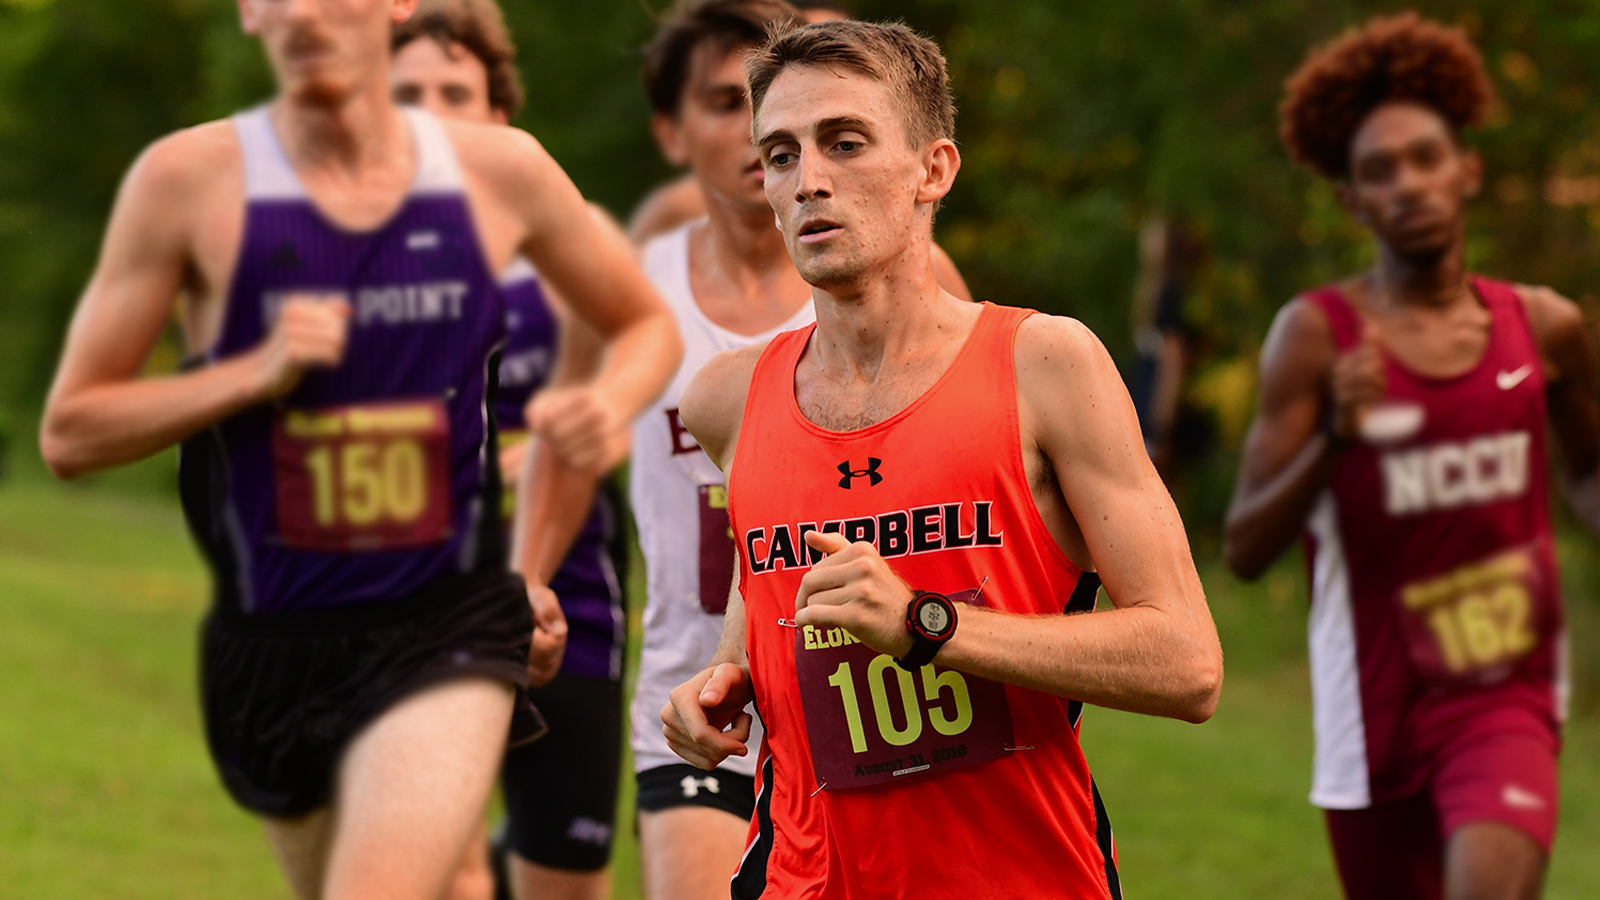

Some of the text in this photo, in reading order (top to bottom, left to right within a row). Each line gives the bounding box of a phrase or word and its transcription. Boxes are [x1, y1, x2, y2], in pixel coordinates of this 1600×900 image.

[356, 282, 467, 326] POINT
[306, 441, 426, 525] 150
[1384, 431, 1530, 514] NCCU
[746, 501, 1003, 575] CAMPBELL
[1430, 585, 1536, 673] 162
[828, 653, 973, 753] 105
